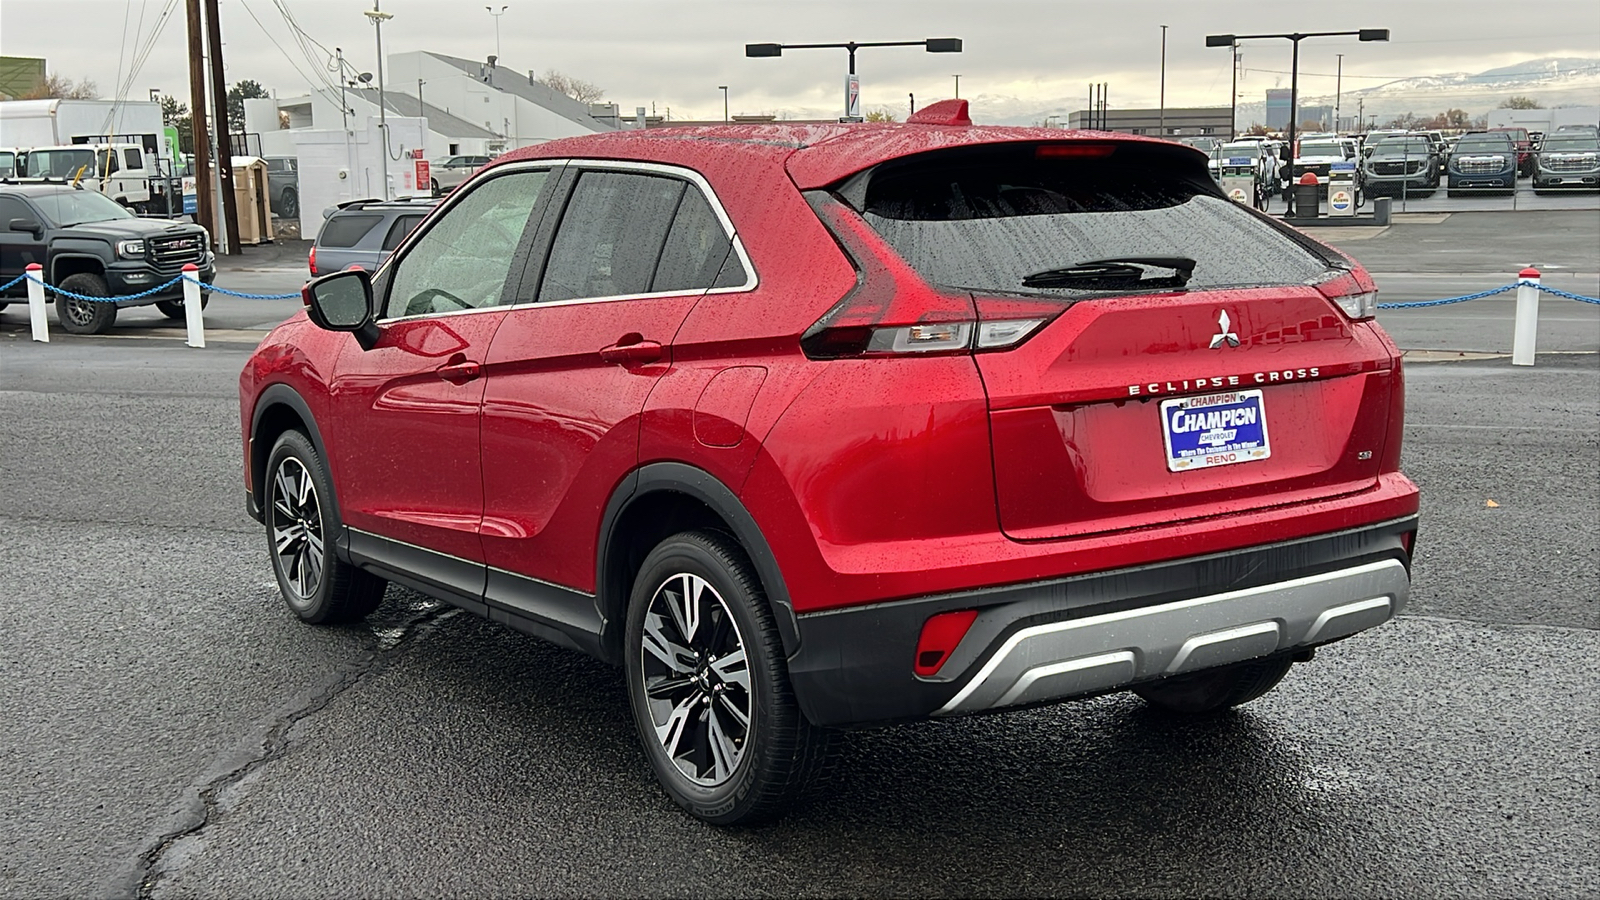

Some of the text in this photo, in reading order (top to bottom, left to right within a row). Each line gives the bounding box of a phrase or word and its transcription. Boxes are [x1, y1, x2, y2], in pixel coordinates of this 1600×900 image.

[1128, 367, 1320, 396] ECLIPSE CROSS
[1190, 393, 1237, 407] CHAMPION
[1172, 407, 1256, 434] CHAMPION
[1201, 431, 1235, 441] CHEVROLET
[1206, 453, 1237, 465] RENO
